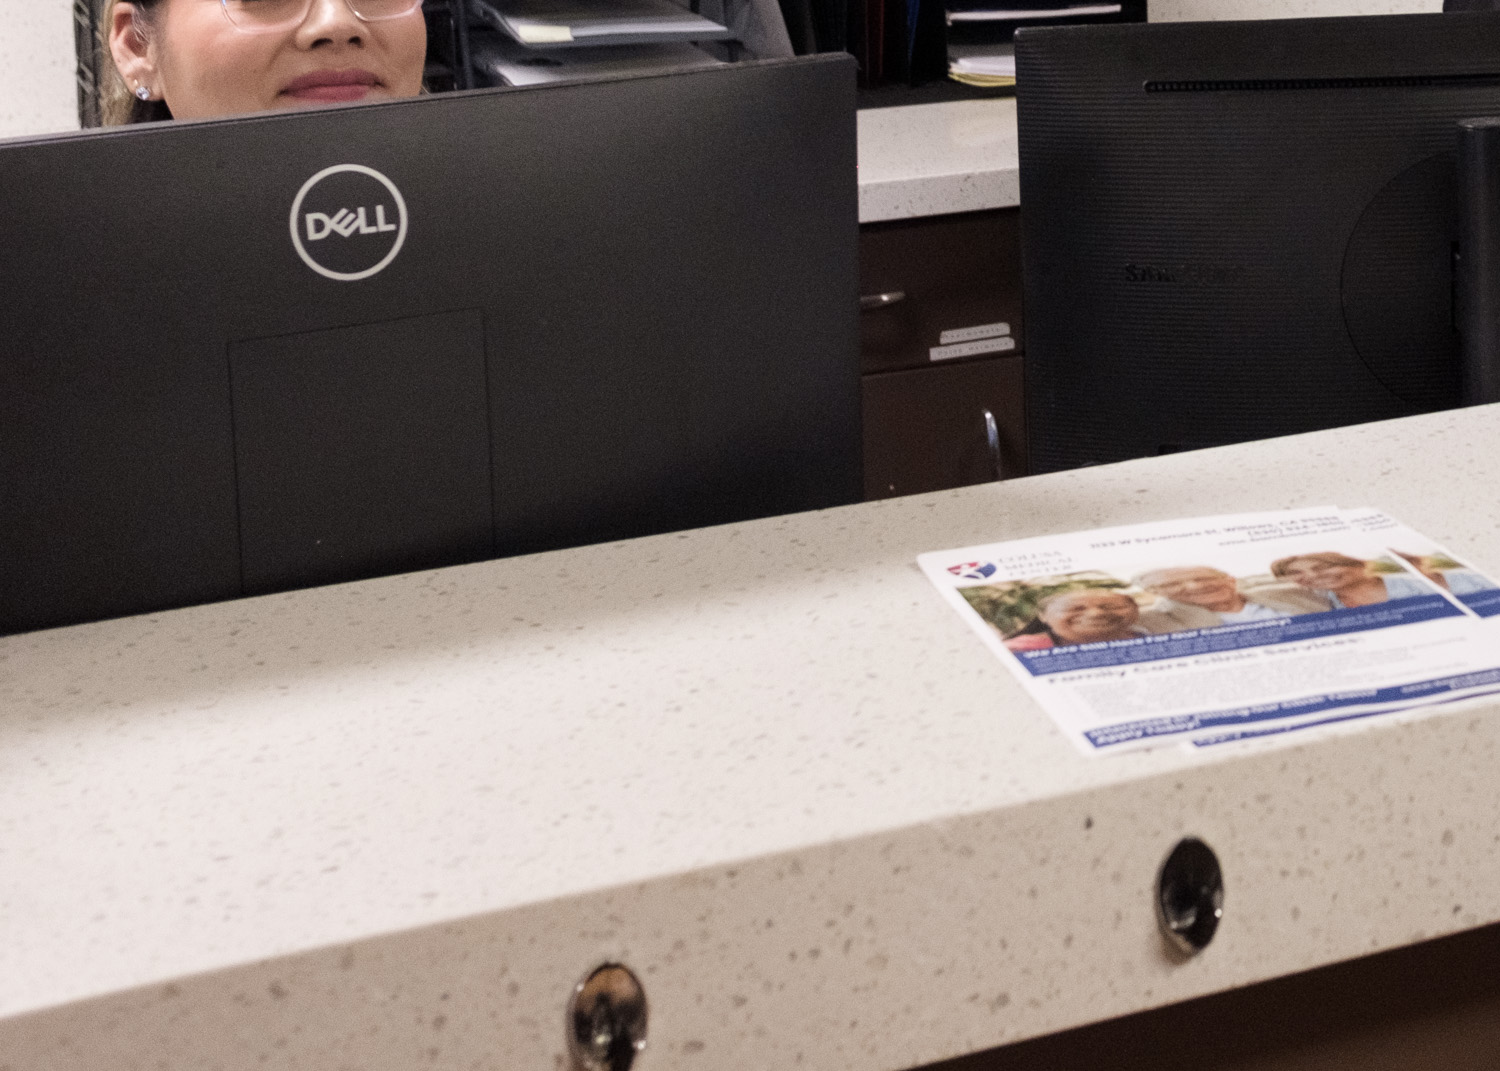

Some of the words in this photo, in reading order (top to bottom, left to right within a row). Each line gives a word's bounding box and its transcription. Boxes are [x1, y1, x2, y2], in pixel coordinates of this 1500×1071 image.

[305, 204, 397, 241] DELL
[1048, 668, 1126, 684] Family
[1133, 661, 1189, 673] Care
[1194, 649, 1258, 665] Clinic
